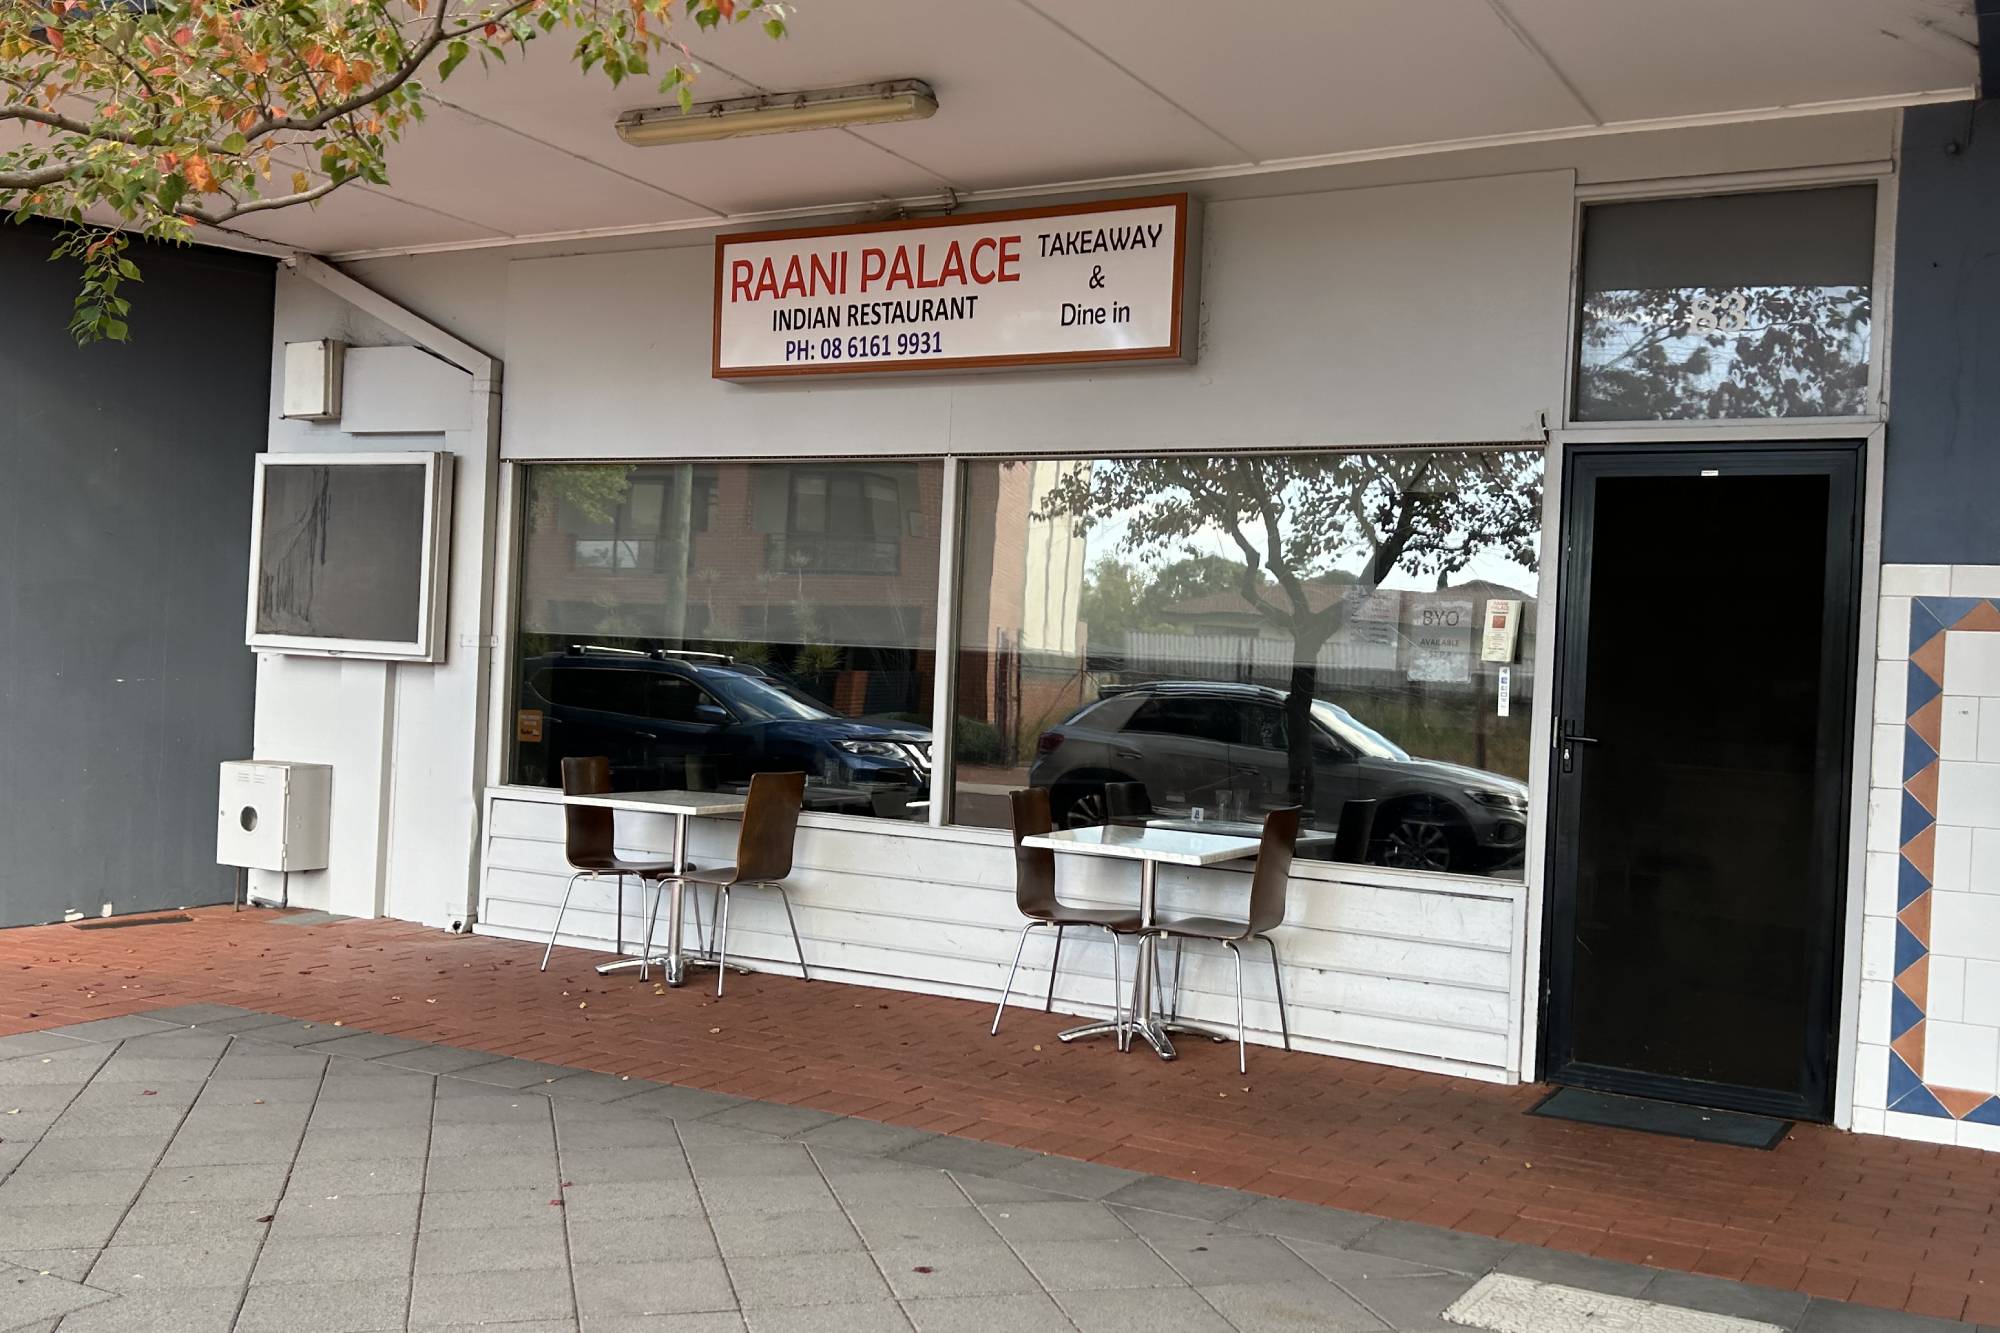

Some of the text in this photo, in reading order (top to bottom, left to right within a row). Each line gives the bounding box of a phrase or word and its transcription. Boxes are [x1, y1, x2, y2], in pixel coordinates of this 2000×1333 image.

[1038, 223, 1162, 257] TAKEAWAY
[731, 235, 1022, 303] RAANI PALACE
[1088, 265, 1105, 289] &
[772, 295, 979, 332] INDIAN RESTAURANT
[1061, 300, 1130, 326] Dine in
[785, 331, 942, 361] PH: 08 6161 9931
[1423, 610, 1459, 627] BYO
